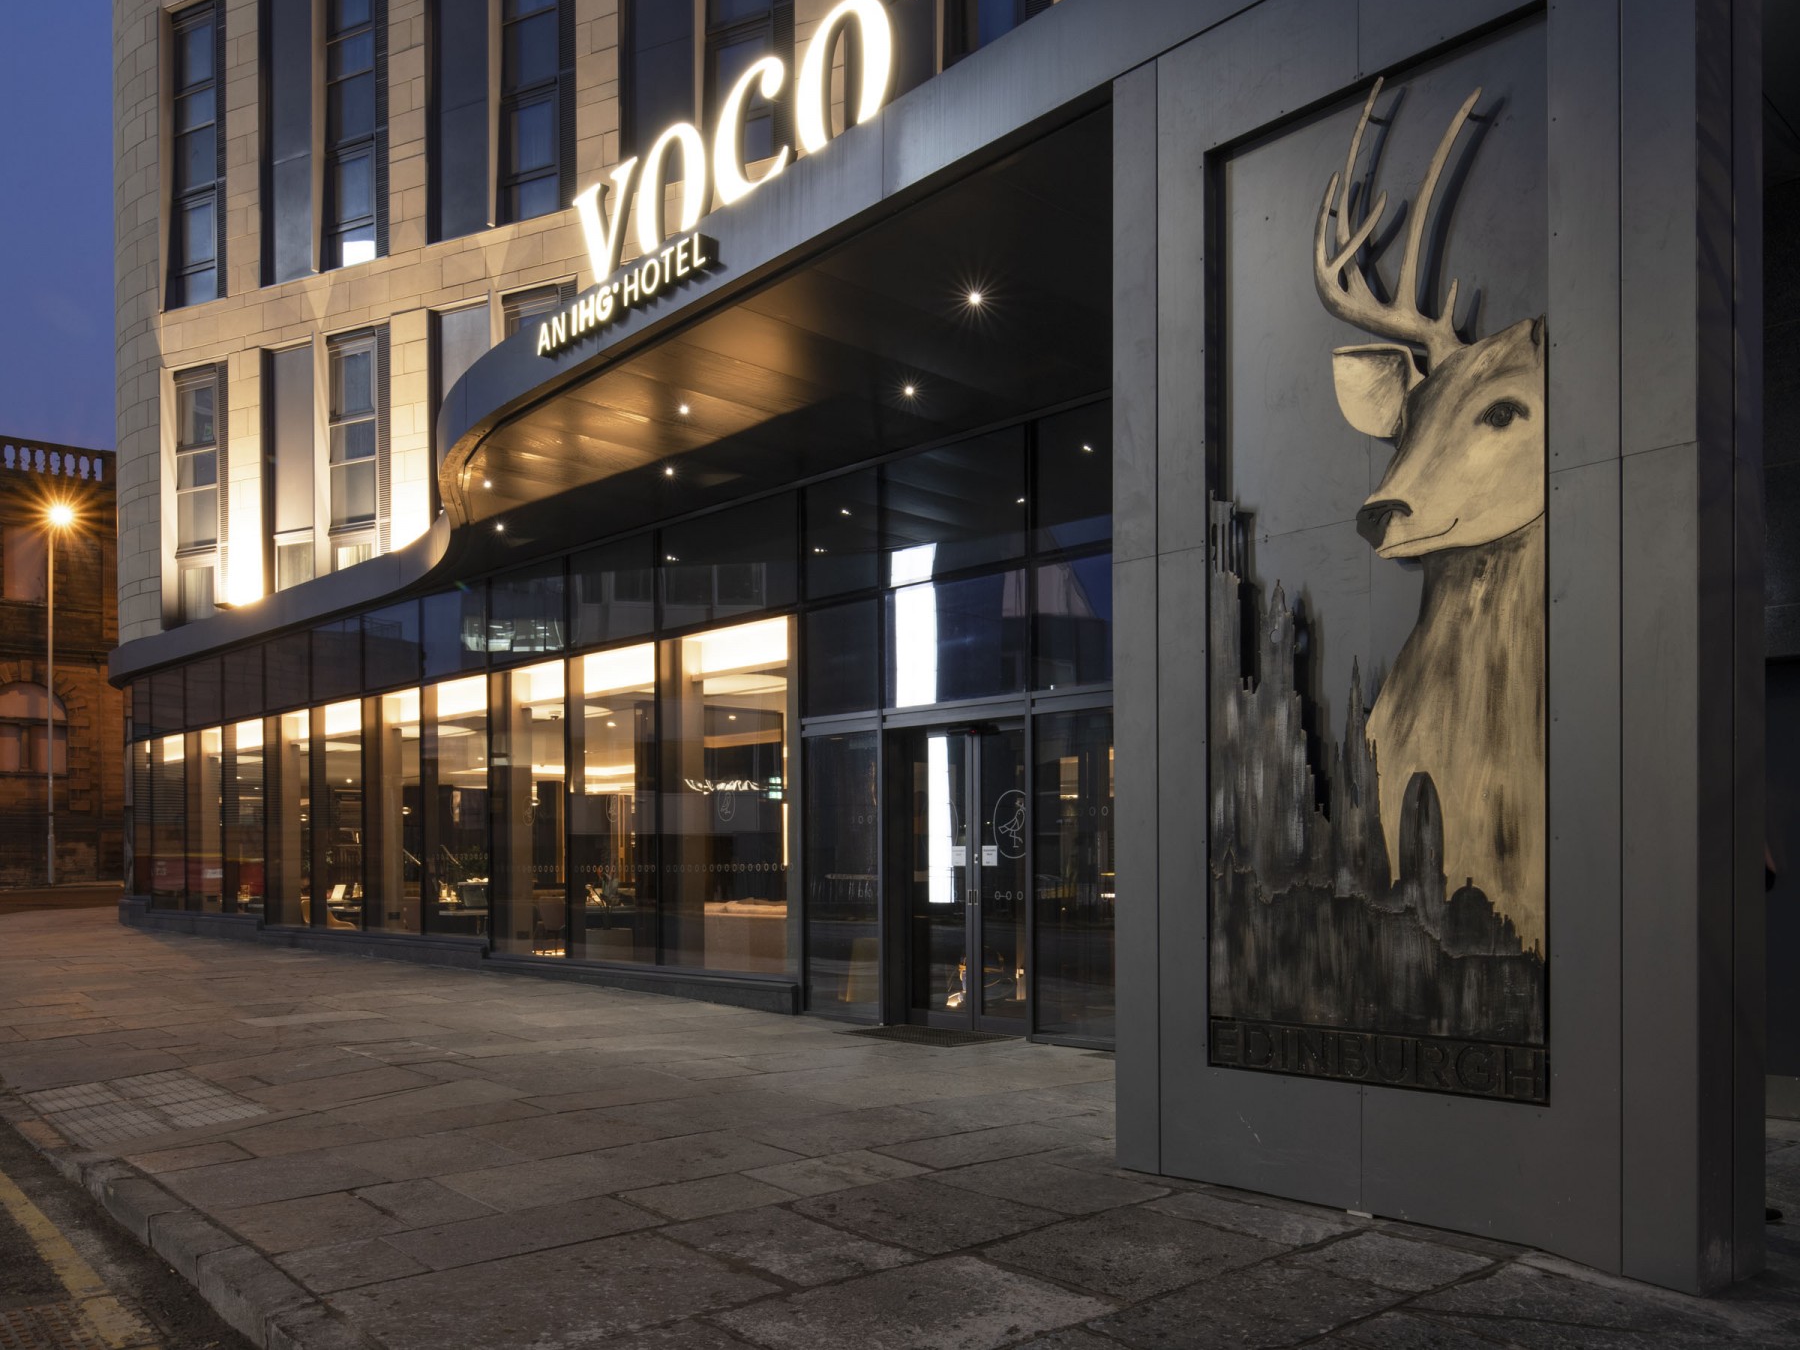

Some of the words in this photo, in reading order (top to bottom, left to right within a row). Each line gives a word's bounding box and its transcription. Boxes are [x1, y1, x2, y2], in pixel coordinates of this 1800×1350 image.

[536, 311, 566, 356] AN
[571, 285, 614, 337] IHG
[623, 231, 707, 307] HOTEL
[1210, 1020, 1547, 1101] EDINBURGH
